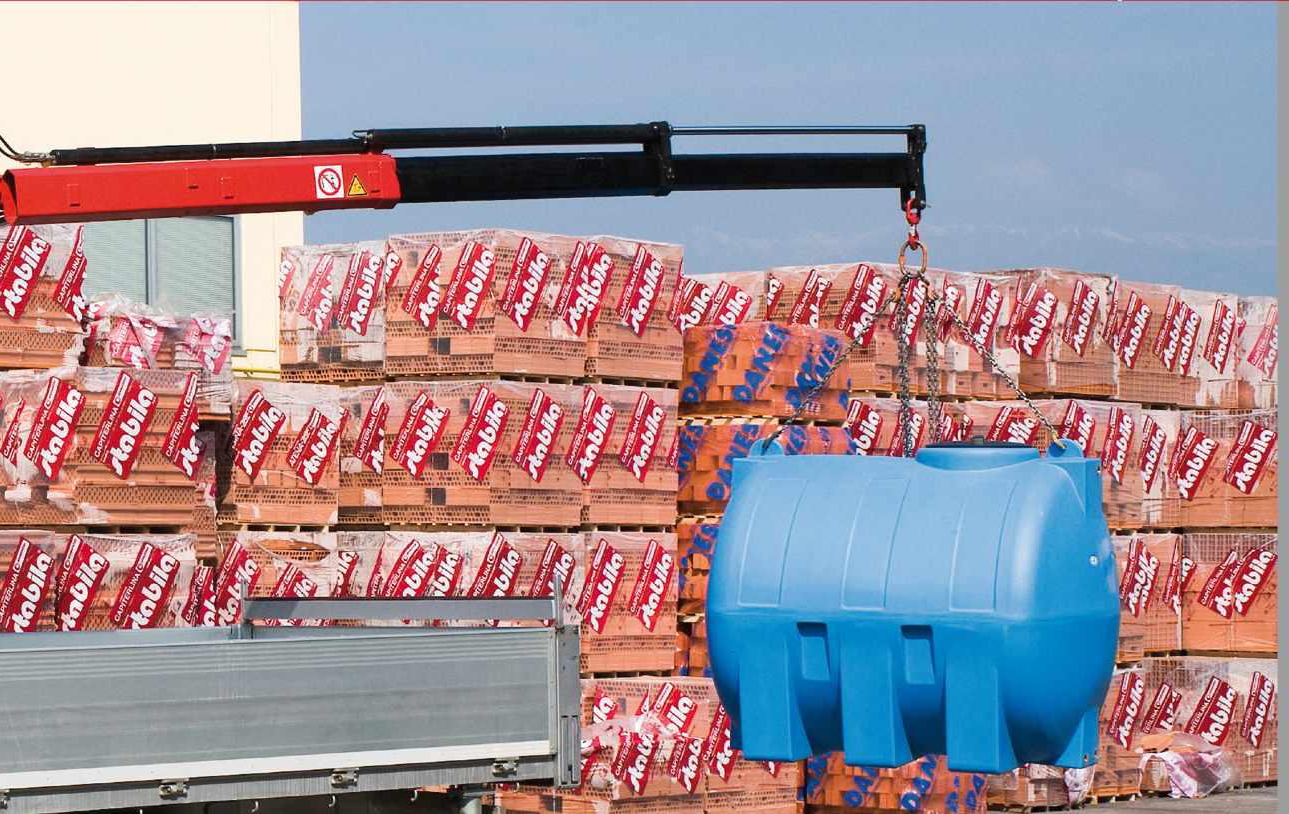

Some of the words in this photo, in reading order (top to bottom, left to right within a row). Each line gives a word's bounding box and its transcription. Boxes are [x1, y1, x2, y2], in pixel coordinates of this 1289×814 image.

[2, 237, 48, 317] stabila
[57, 256, 82, 303] CAPITERLINA
[300, 275, 321, 315] CAPITERLINA
[337, 275, 356, 321] CAPITERLINA
[349, 255, 382, 334] stabila
[405, 268, 428, 312] CAPITERLINA
[443, 268, 465, 313] CAPITERLINA
[456, 249, 496, 329] stabila
[502, 265, 522, 311] CAPITERLINA
[514, 251, 550, 329] stabila
[556, 272, 576, 314] CAPITERLINA
[619, 274, 639, 316] CAPITERLINA
[630, 260, 663, 334] stabila
[837, 286, 860, 330] CAPITERLINA
[1023, 292, 1056, 356] stabila
[1072, 290, 1098, 355] stabila
[1124, 304, 1151, 368] stabila
[1213, 310, 1235, 372] stabila
[26, 410, 49, 459] CAPITERLINA
[40, 388, 82, 477] stabila
[94, 407, 119, 458] CAPITERLINA
[109, 388, 155, 476] stabila
[165, 406, 190, 457] CAPITERLINA
[240, 406, 283, 477] stabila
[303, 422, 338, 484] stabila
[356, 416, 377, 458] CAPITERLINA
[393, 416, 414, 460] CAPITERLINA
[454, 418, 478, 461] CAPITERLINA
[467, 400, 506, 480] stabila
[515, 418, 535, 463] CAPITERLINA
[527, 403, 563, 481] stabila
[568, 421, 587, 466] CAPITERLINA
[578, 403, 615, 481] stabila
[621, 420, 639, 463] CAPITERLINA
[632, 405, 664, 480] stabila
[1111, 415, 1133, 483] stabila
[1141, 428, 1167, 491] stabila
[1234, 429, 1274, 493] stabila
[1177, 438, 1216, 499] stabila
[114, 573, 141, 622] CAPITERLINA
[590, 553, 625, 633] stabila
[630, 570, 648, 613] CAPITERLINA
[640, 553, 673, 629] stabila
[1201, 566, 1224, 605] CAPITERLINA
[1234, 551, 1274, 615] stabila
[703, 715, 725, 762] CAPITERLINA
[1119, 679, 1145, 748] stabila
[1249, 680, 1273, 748] stabila
